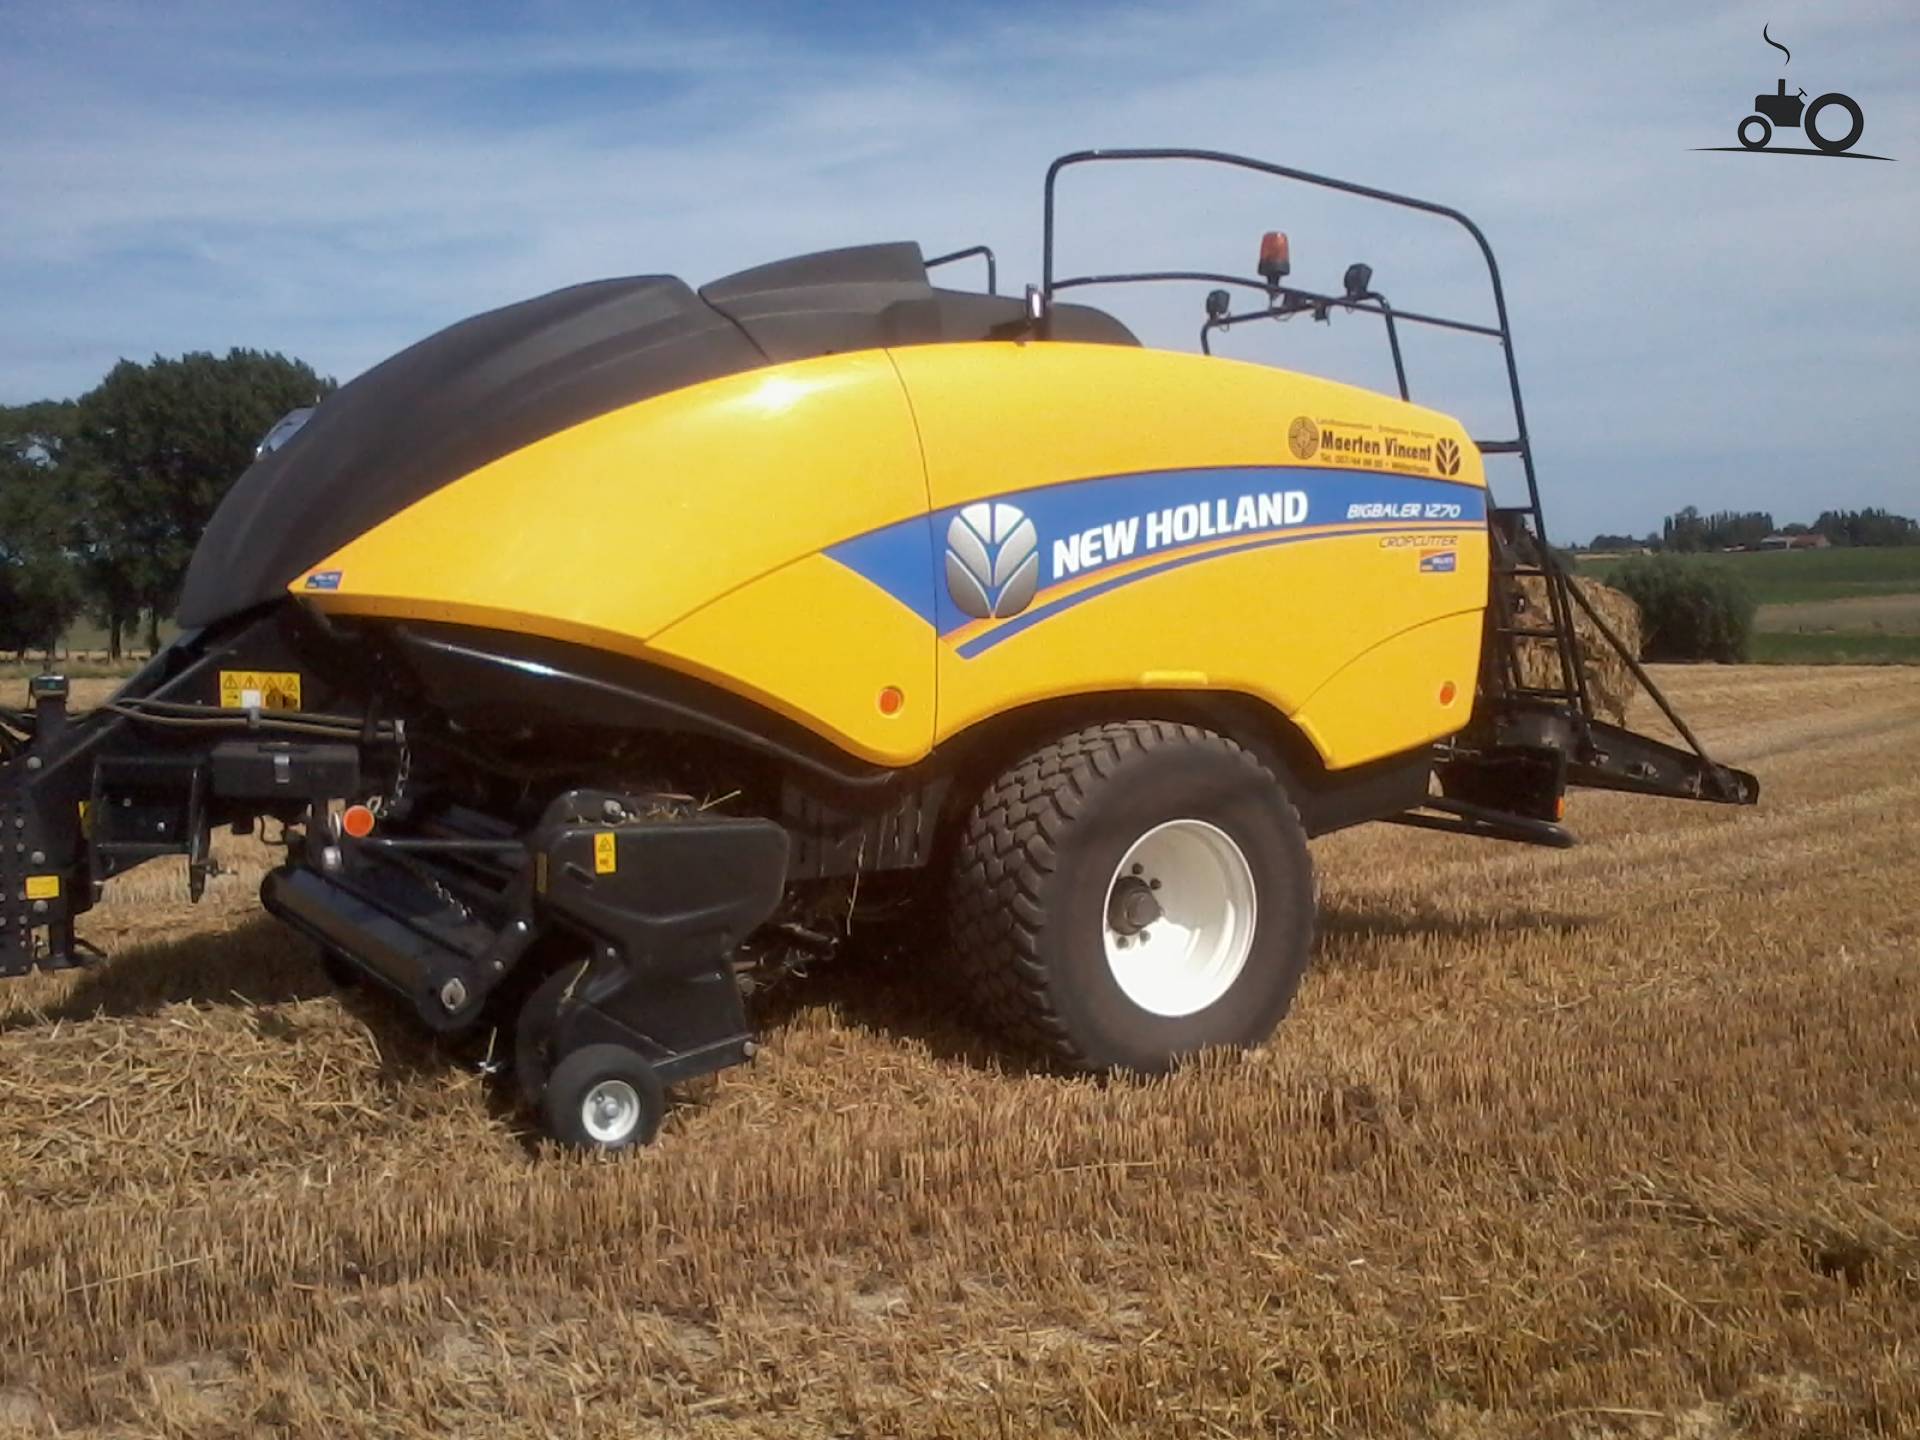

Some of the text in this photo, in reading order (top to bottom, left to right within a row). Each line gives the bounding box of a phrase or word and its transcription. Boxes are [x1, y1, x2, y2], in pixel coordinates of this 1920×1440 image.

[1384, 437, 1431, 461] Vincent
[1347, 503, 1461, 519] BIGBALER 1270
[1053, 490, 1309, 579] NEW HOLLAND
[1379, 535, 1458, 549] CROPCUTTER
